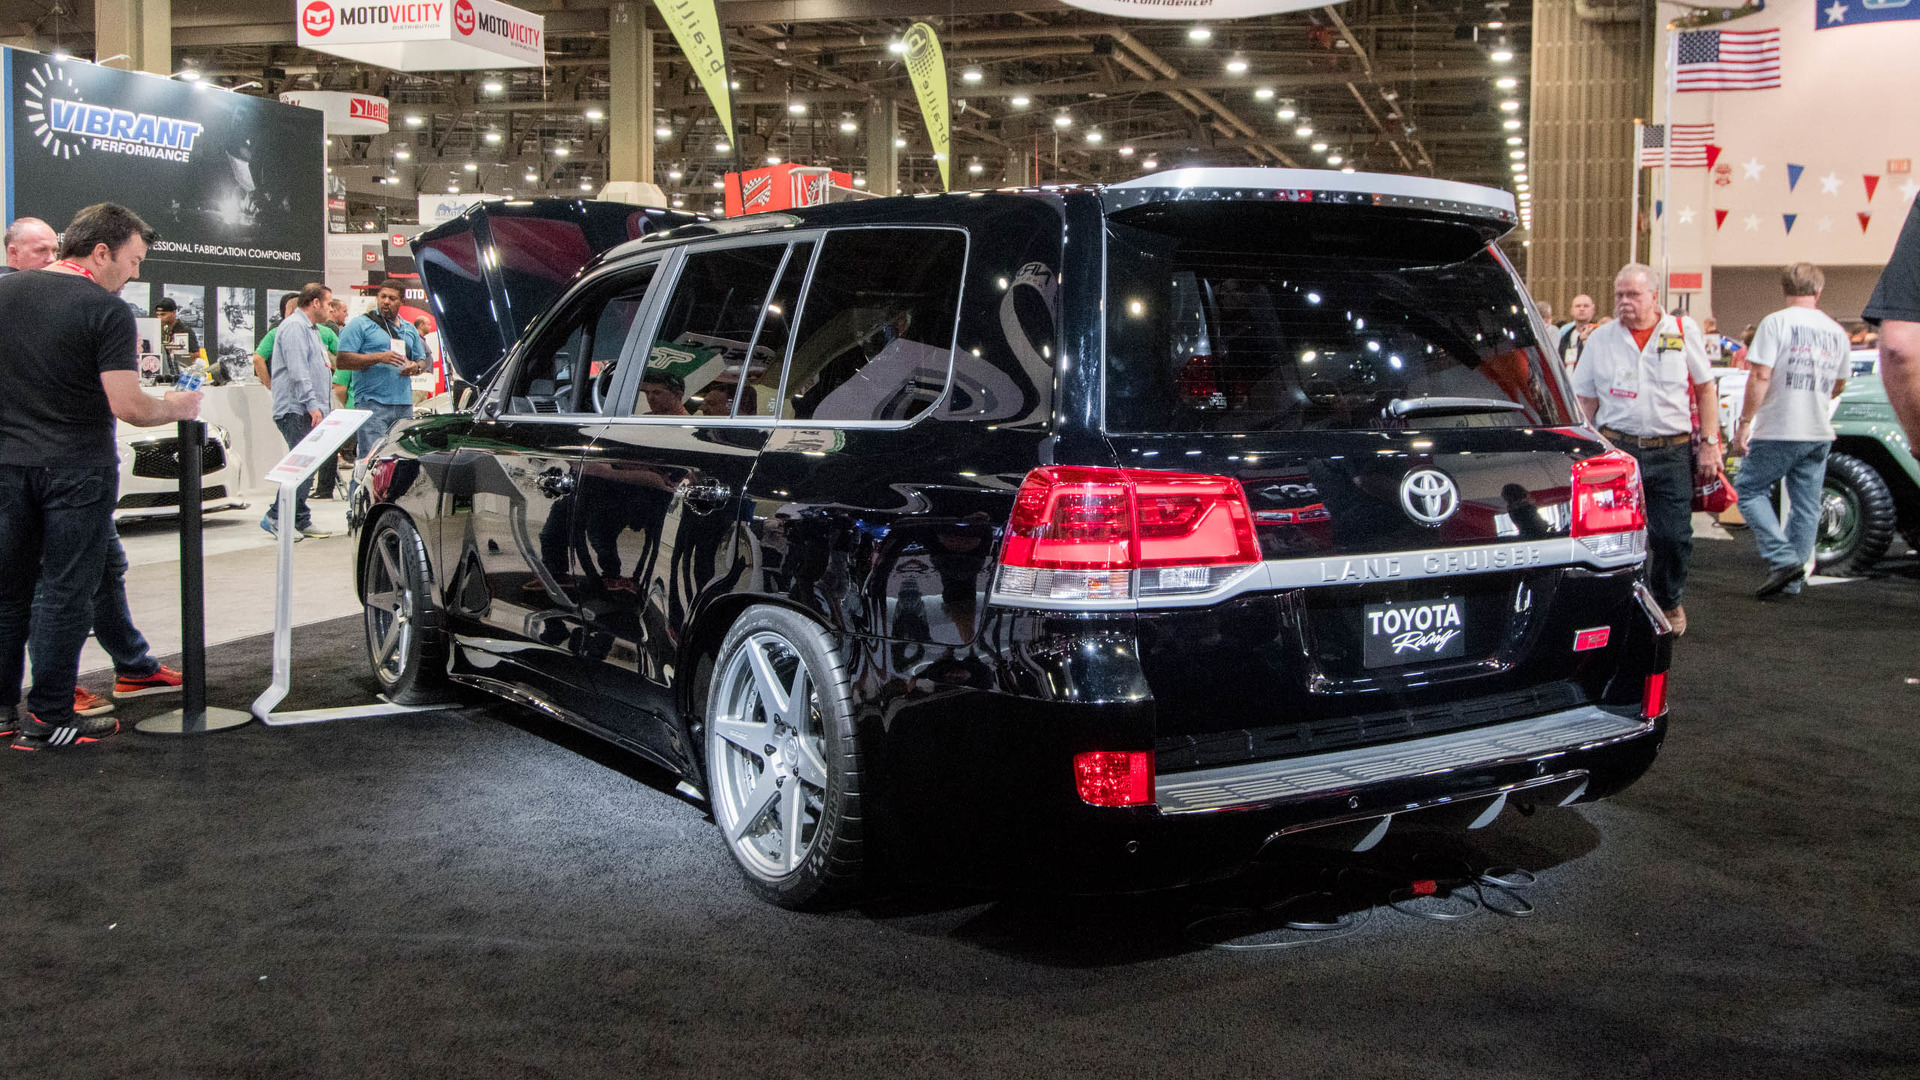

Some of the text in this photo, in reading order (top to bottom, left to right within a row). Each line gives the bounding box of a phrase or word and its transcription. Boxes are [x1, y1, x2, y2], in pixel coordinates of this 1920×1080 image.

[340, 2, 444, 26] MOTOVICITY
[478, 11, 540, 48] MOTOVICITY
[51, 98, 202, 152] VIBRANT
[92, 138, 191, 164] PERFORMANCE
[151, 240, 194, 254] ESSIONAL
[194, 243, 248, 258] FABRICATION
[247, 247, 302, 262] COMPONENTS
[1320, 546, 1541, 583] LAND CRUISER
[1368, 603, 1461, 635] TOYOTA
[1391, 628, 1461, 655] Racing
